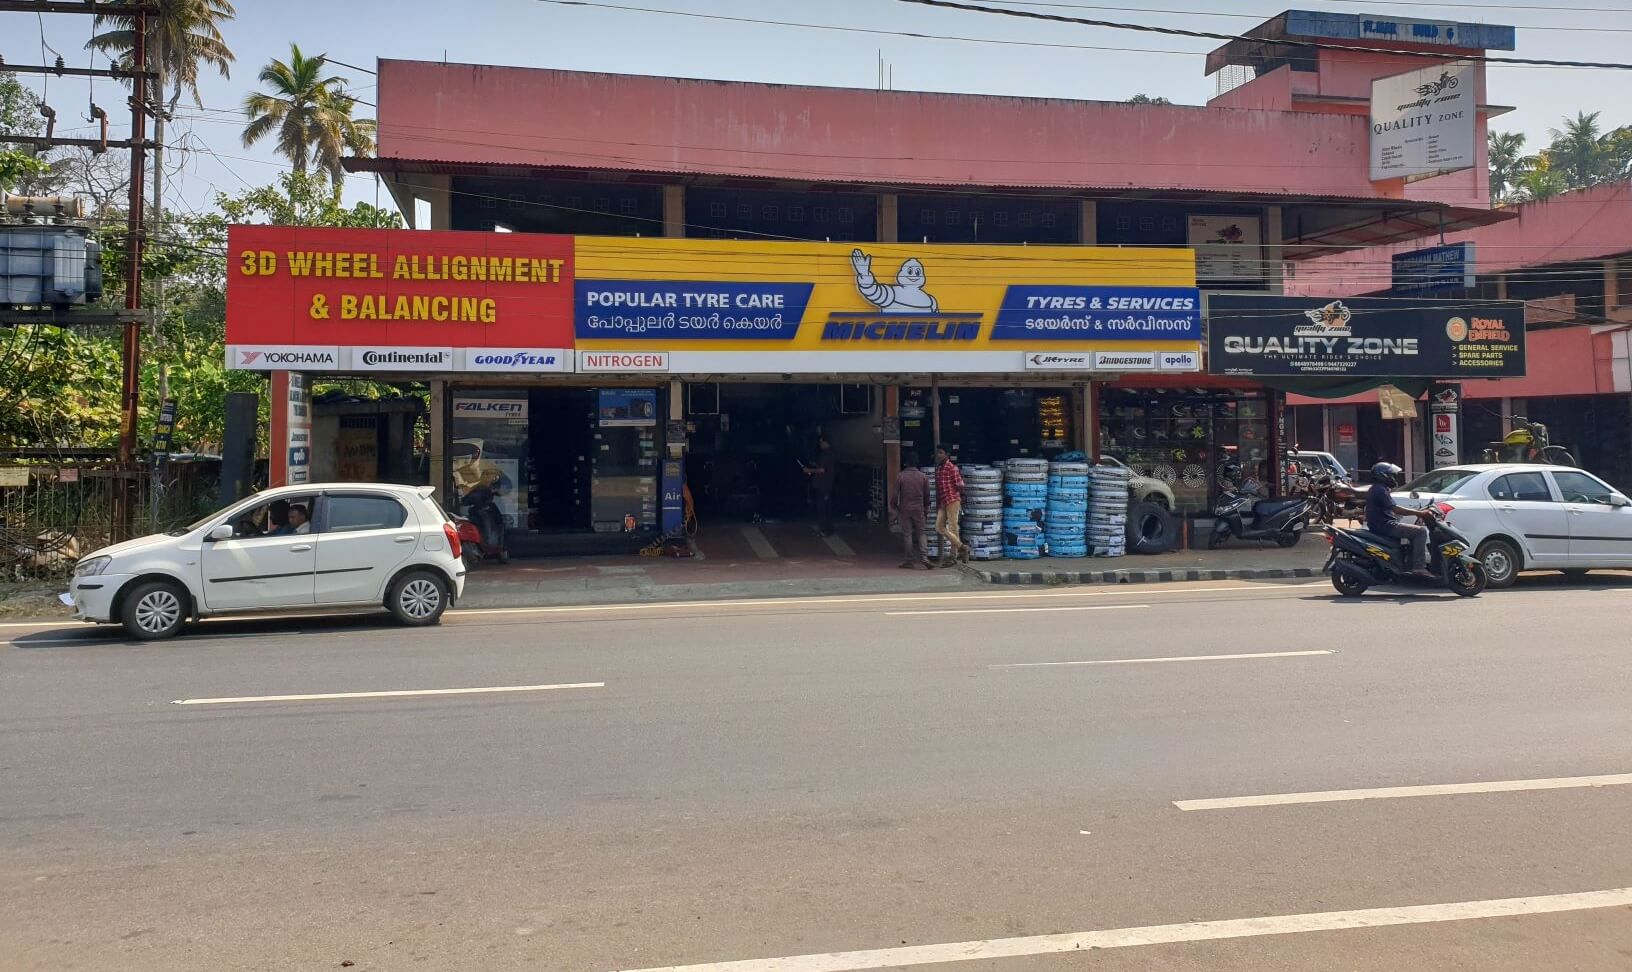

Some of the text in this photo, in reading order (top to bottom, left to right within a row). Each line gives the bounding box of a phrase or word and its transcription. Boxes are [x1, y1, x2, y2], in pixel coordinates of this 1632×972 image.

[1373, 114, 1433, 135] QUALITY
[240, 250, 565, 284] 3D WHEEL ALLIGNMENT
[587, 291, 785, 309] POPULAR TYRE CARE
[1026, 296, 1194, 311] TYRES & SERVICES
[309, 294, 497, 323] & BALANCING
[587, 313, 783, 333] പോപ്പുലർ ടയർ കെയർ
[1094, 319, 1103, 330] &
[1471, 317, 1506, 330] ROYAL
[821, 321, 982, 341] MICHELIN
[1223, 336, 1419, 355] QUALITY ZONE
[1490, 344, 1519, 352] SERVICE
[263, 351, 334, 365] YOKOHAMA
[362, 350, 444, 366] Continental
[587, 355, 663, 368] NITROGEN
[1098, 355, 1152, 365] BRIDGESTONE
[1165, 354, 1192, 365] apollo
[664, 491, 681, 501] Air
